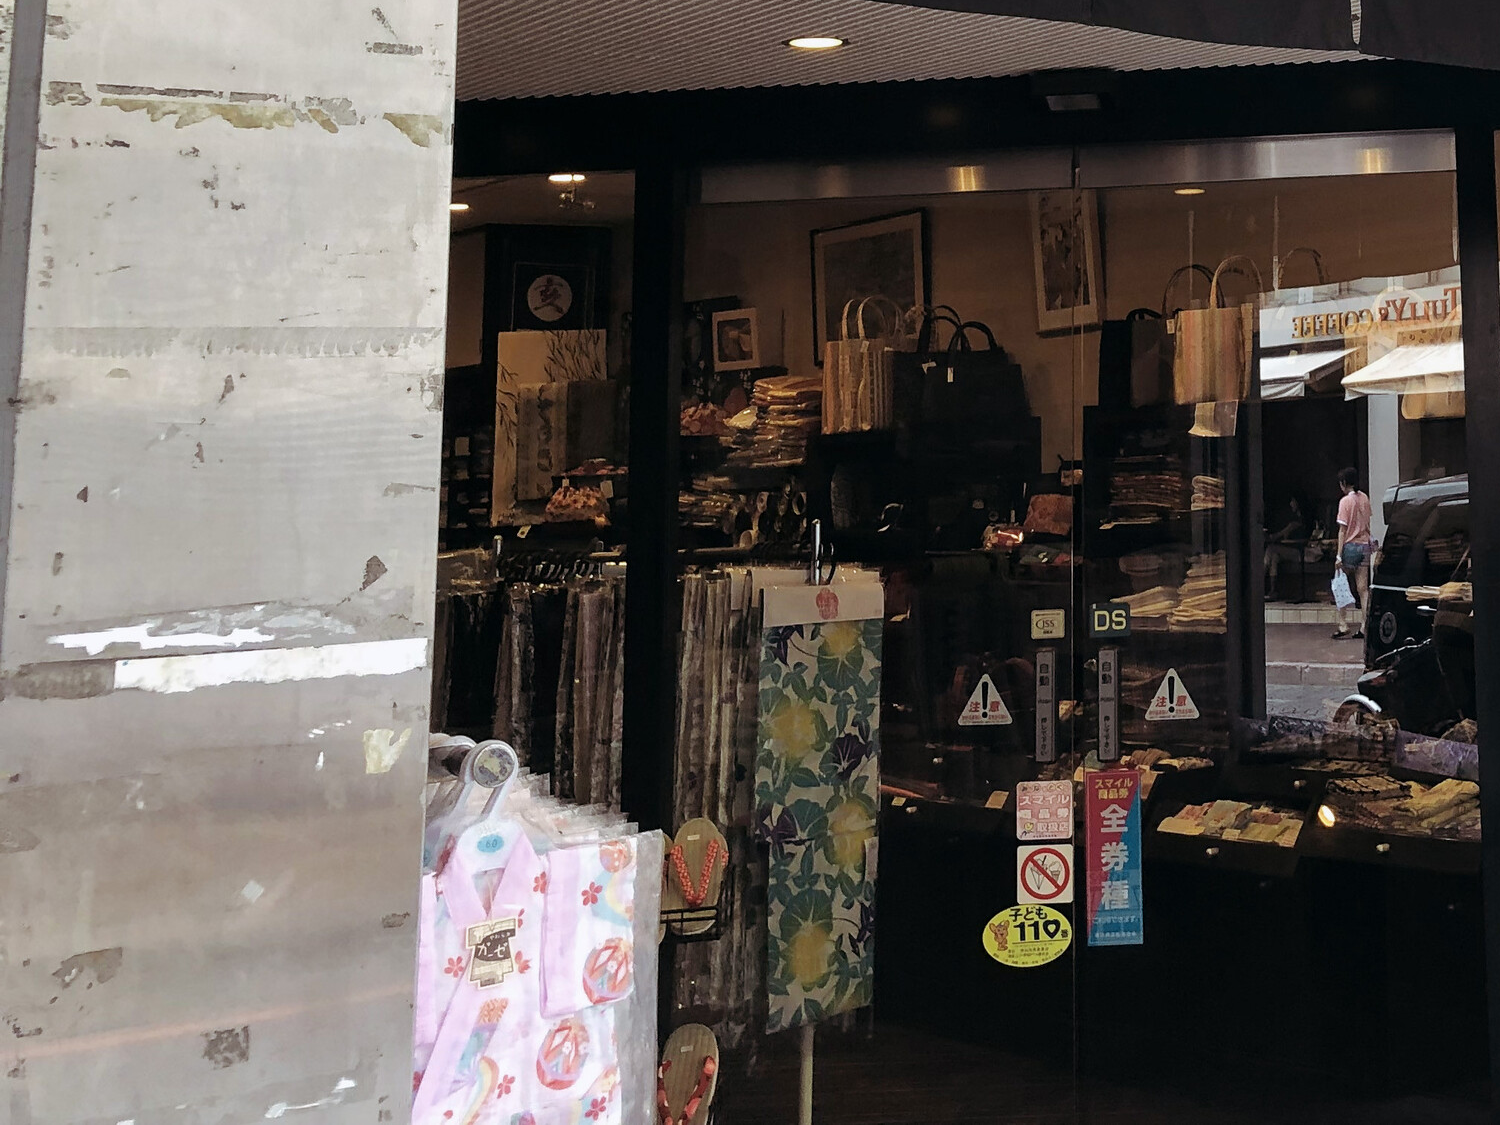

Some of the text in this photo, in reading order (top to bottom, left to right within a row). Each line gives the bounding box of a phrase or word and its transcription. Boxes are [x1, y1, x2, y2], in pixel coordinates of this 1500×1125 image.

[1094, 609, 1127, 631] DS
[1095, 777, 1134, 789] スマイル
[1019, 794, 1069, 806] スマイル
[1100, 803, 1130, 910] 全券種
[1008, 906, 1049, 923] 子ども
[477, 941, 508, 958] ガーゼ
